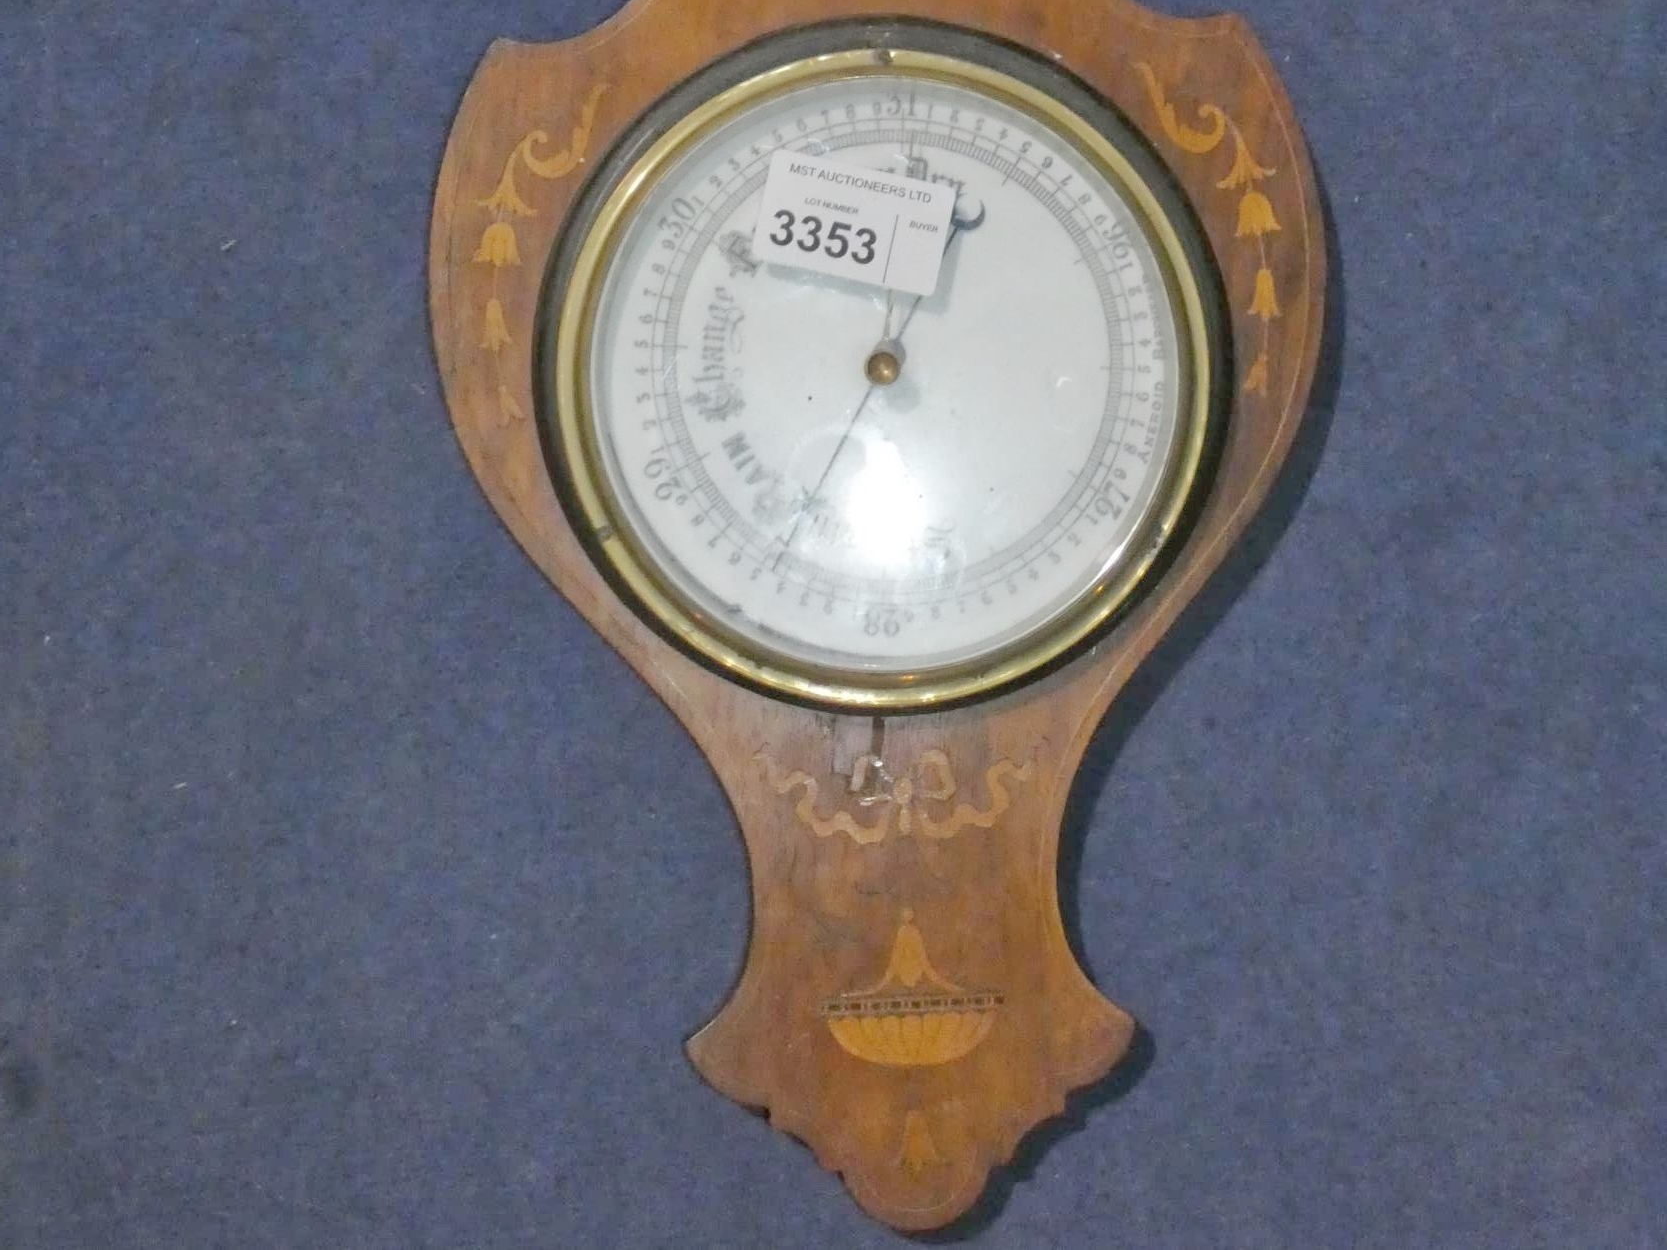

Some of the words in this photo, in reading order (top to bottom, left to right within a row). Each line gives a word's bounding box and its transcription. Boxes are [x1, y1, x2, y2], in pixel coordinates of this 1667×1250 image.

[789, 163, 821, 178] MST
[817, 169, 906, 198] AUCTIONEERS
[909, 188, 932, 203] LTD
[657, 197, 697, 237] 30
[804, 197, 822, 208] LOT
[822, 201, 860, 215] NUMBER
[769, 209, 877, 264] 3353
[909, 220, 939, 233] BUYER
